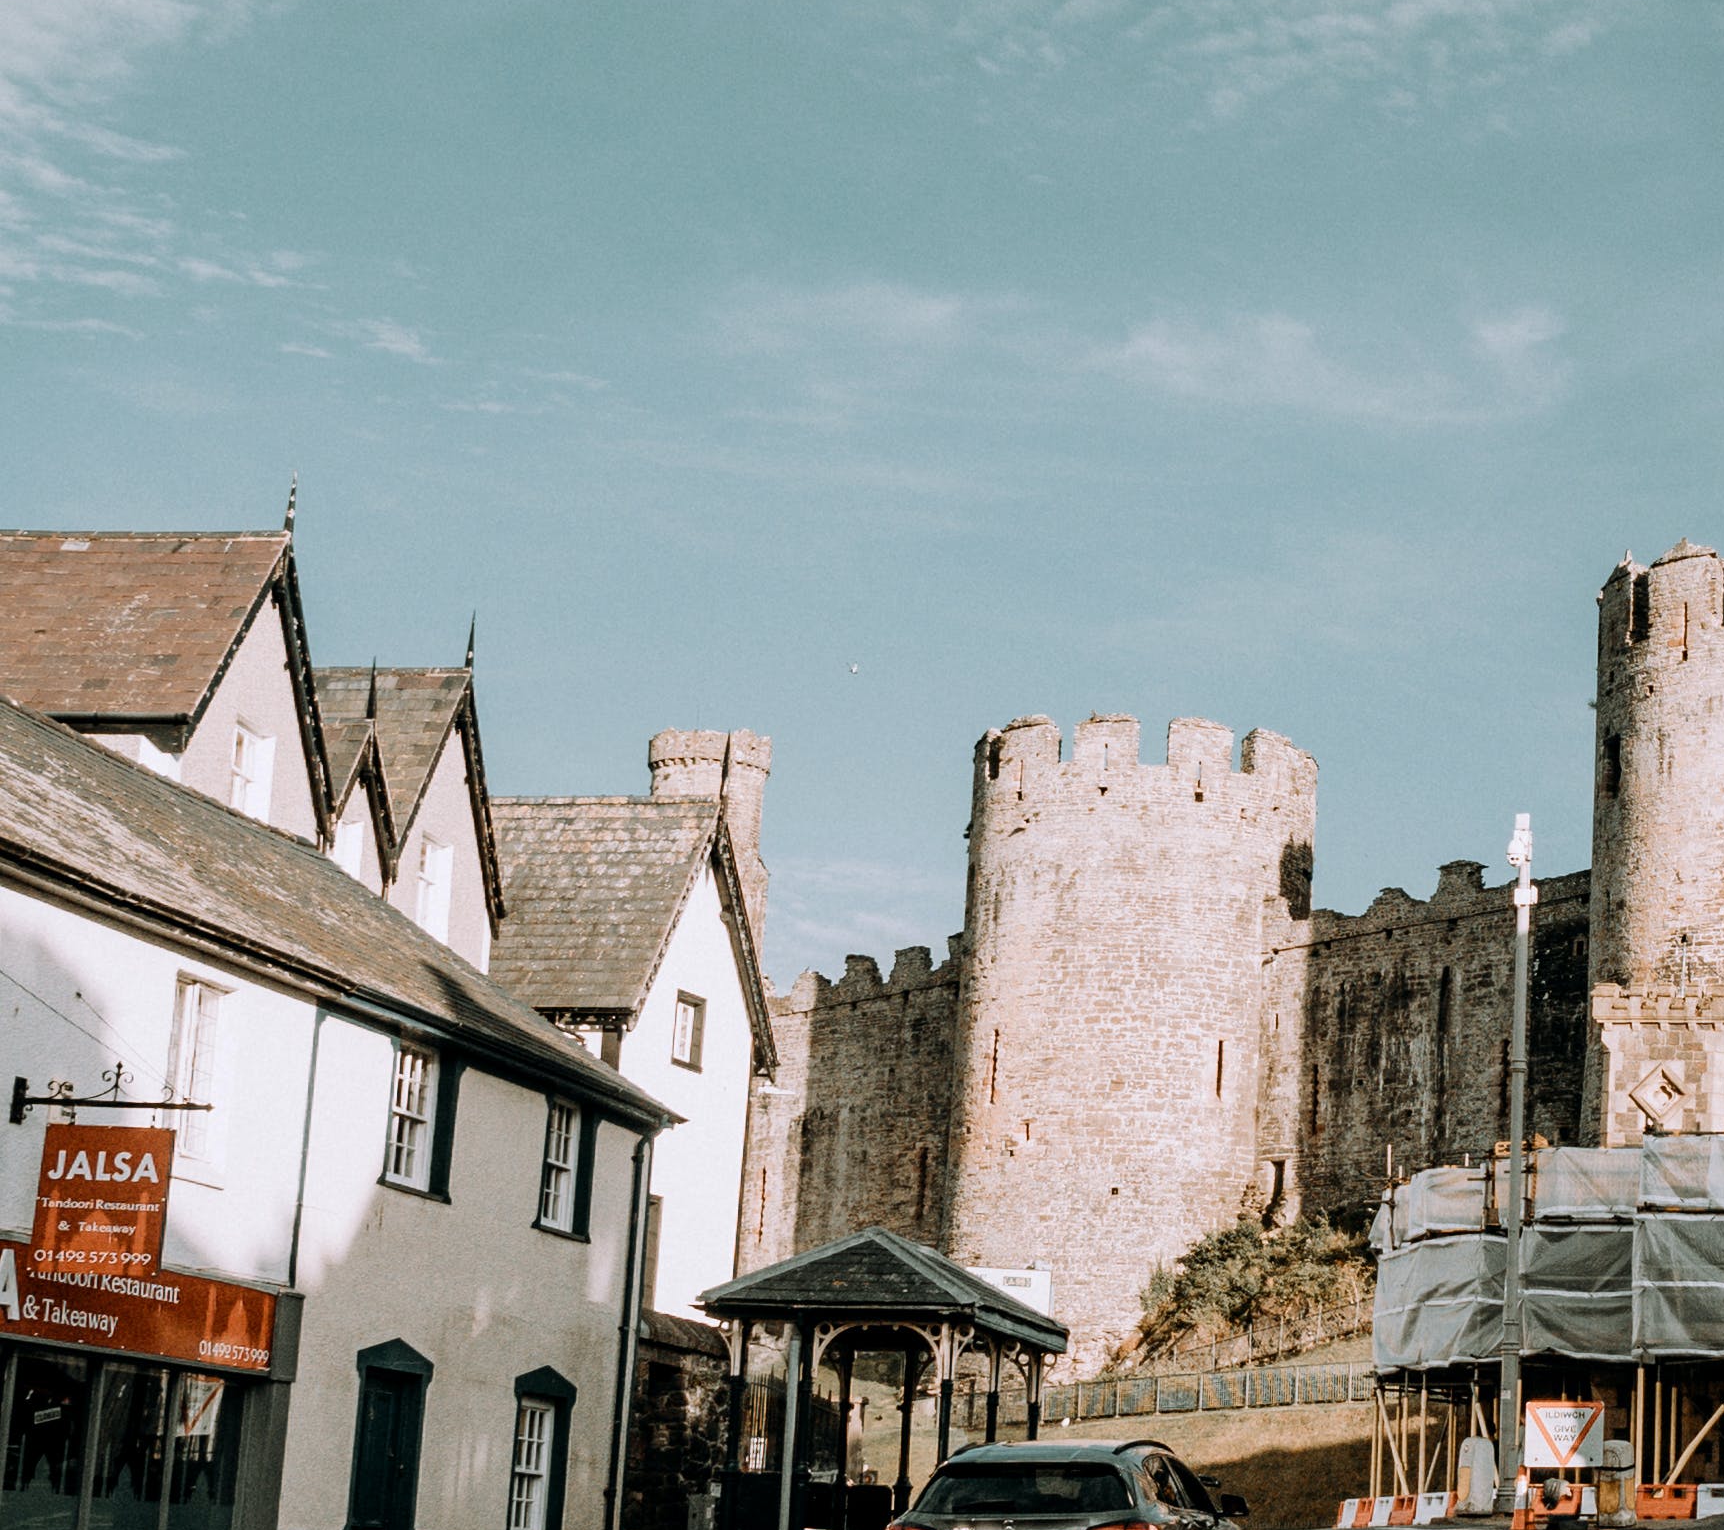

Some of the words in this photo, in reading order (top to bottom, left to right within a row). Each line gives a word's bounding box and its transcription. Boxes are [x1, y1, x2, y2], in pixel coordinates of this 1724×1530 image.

[47, 1149, 160, 1184] JALSA
[41, 1197, 94, 1210] Tandoori
[95, 1199, 160, 1212] Restaurant
[58, 1221, 71, 1232] &
[78, 1221, 137, 1236] Takeaway
[34, 1249, 86, 1264] 01492
[89, 1251, 118, 1265] 573
[120, 1253, 152, 1266] 999
[23, 1294, 40, 1320] &
[42, 1298, 119, 1338] Takeaway
[198, 1339, 231, 1359] 01492
[232, 1344, 250, 1362] 573
[251, 1348, 270, 1364] 999
[1554, 1424, 1577, 1433] GIVE
[1553, 1434, 1577, 1442] WAY
